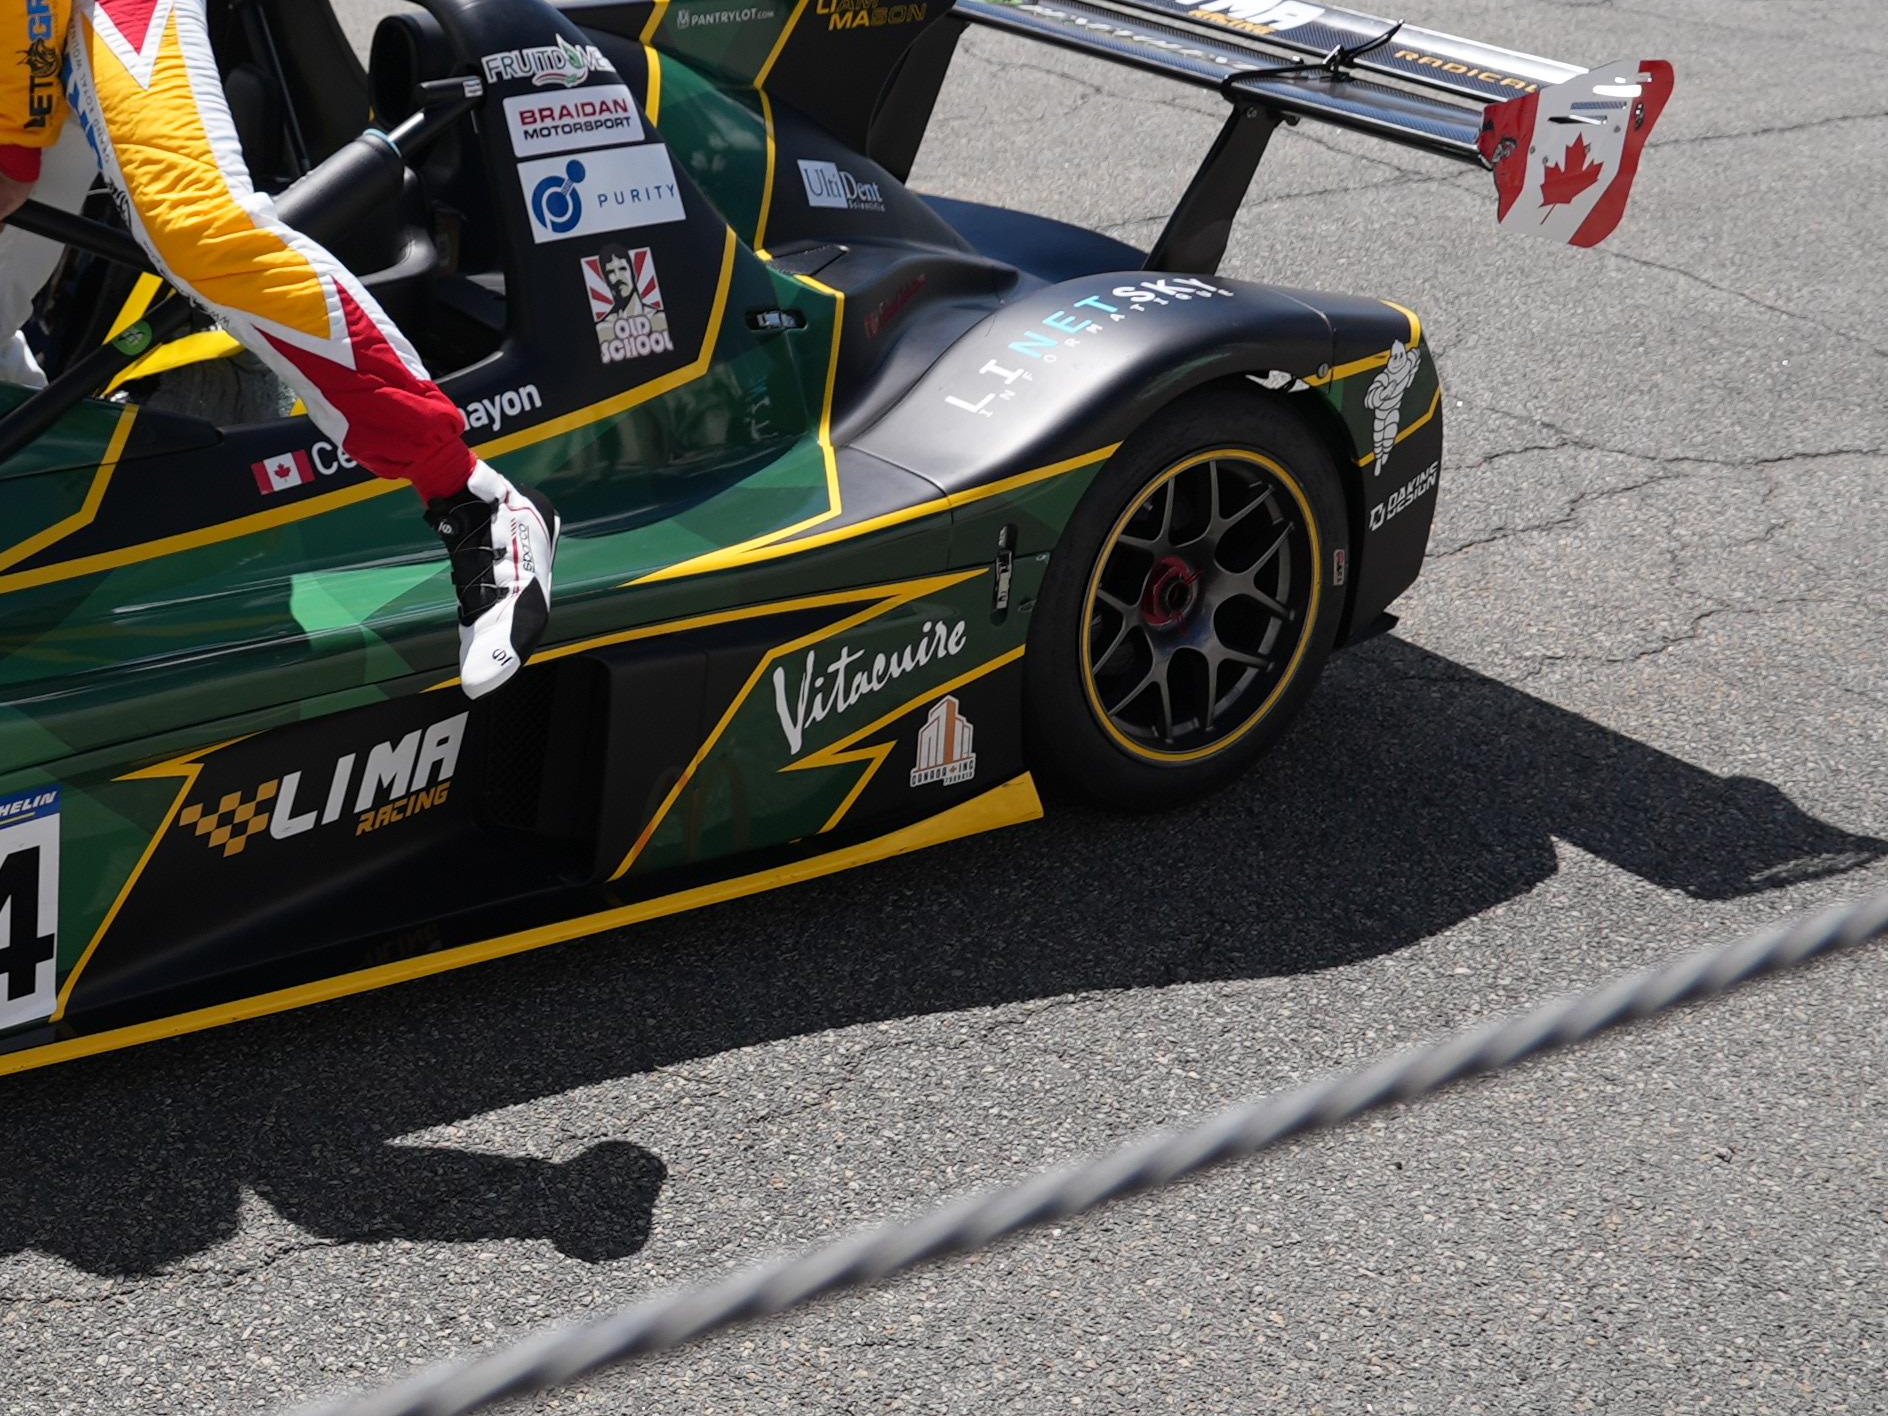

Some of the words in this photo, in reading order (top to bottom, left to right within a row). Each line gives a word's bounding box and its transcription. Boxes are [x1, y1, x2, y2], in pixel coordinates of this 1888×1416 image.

[828, 2, 927, 31] MASON
[1188, 9, 1279, 35] RACING
[1394, 49, 1540, 94] RADICAL
[519, 98, 628, 126] BRAIDAN
[524, 117, 631, 140] MOTORSPORT
[597, 183, 675, 208] PURITY
[614, 315, 651, 339] OLD
[601, 330, 674, 364] SCHOOL
[773, 620, 967, 756] Vitacuire
[270, 712, 470, 840] LIMA
[355, 782, 451, 836] RACING
